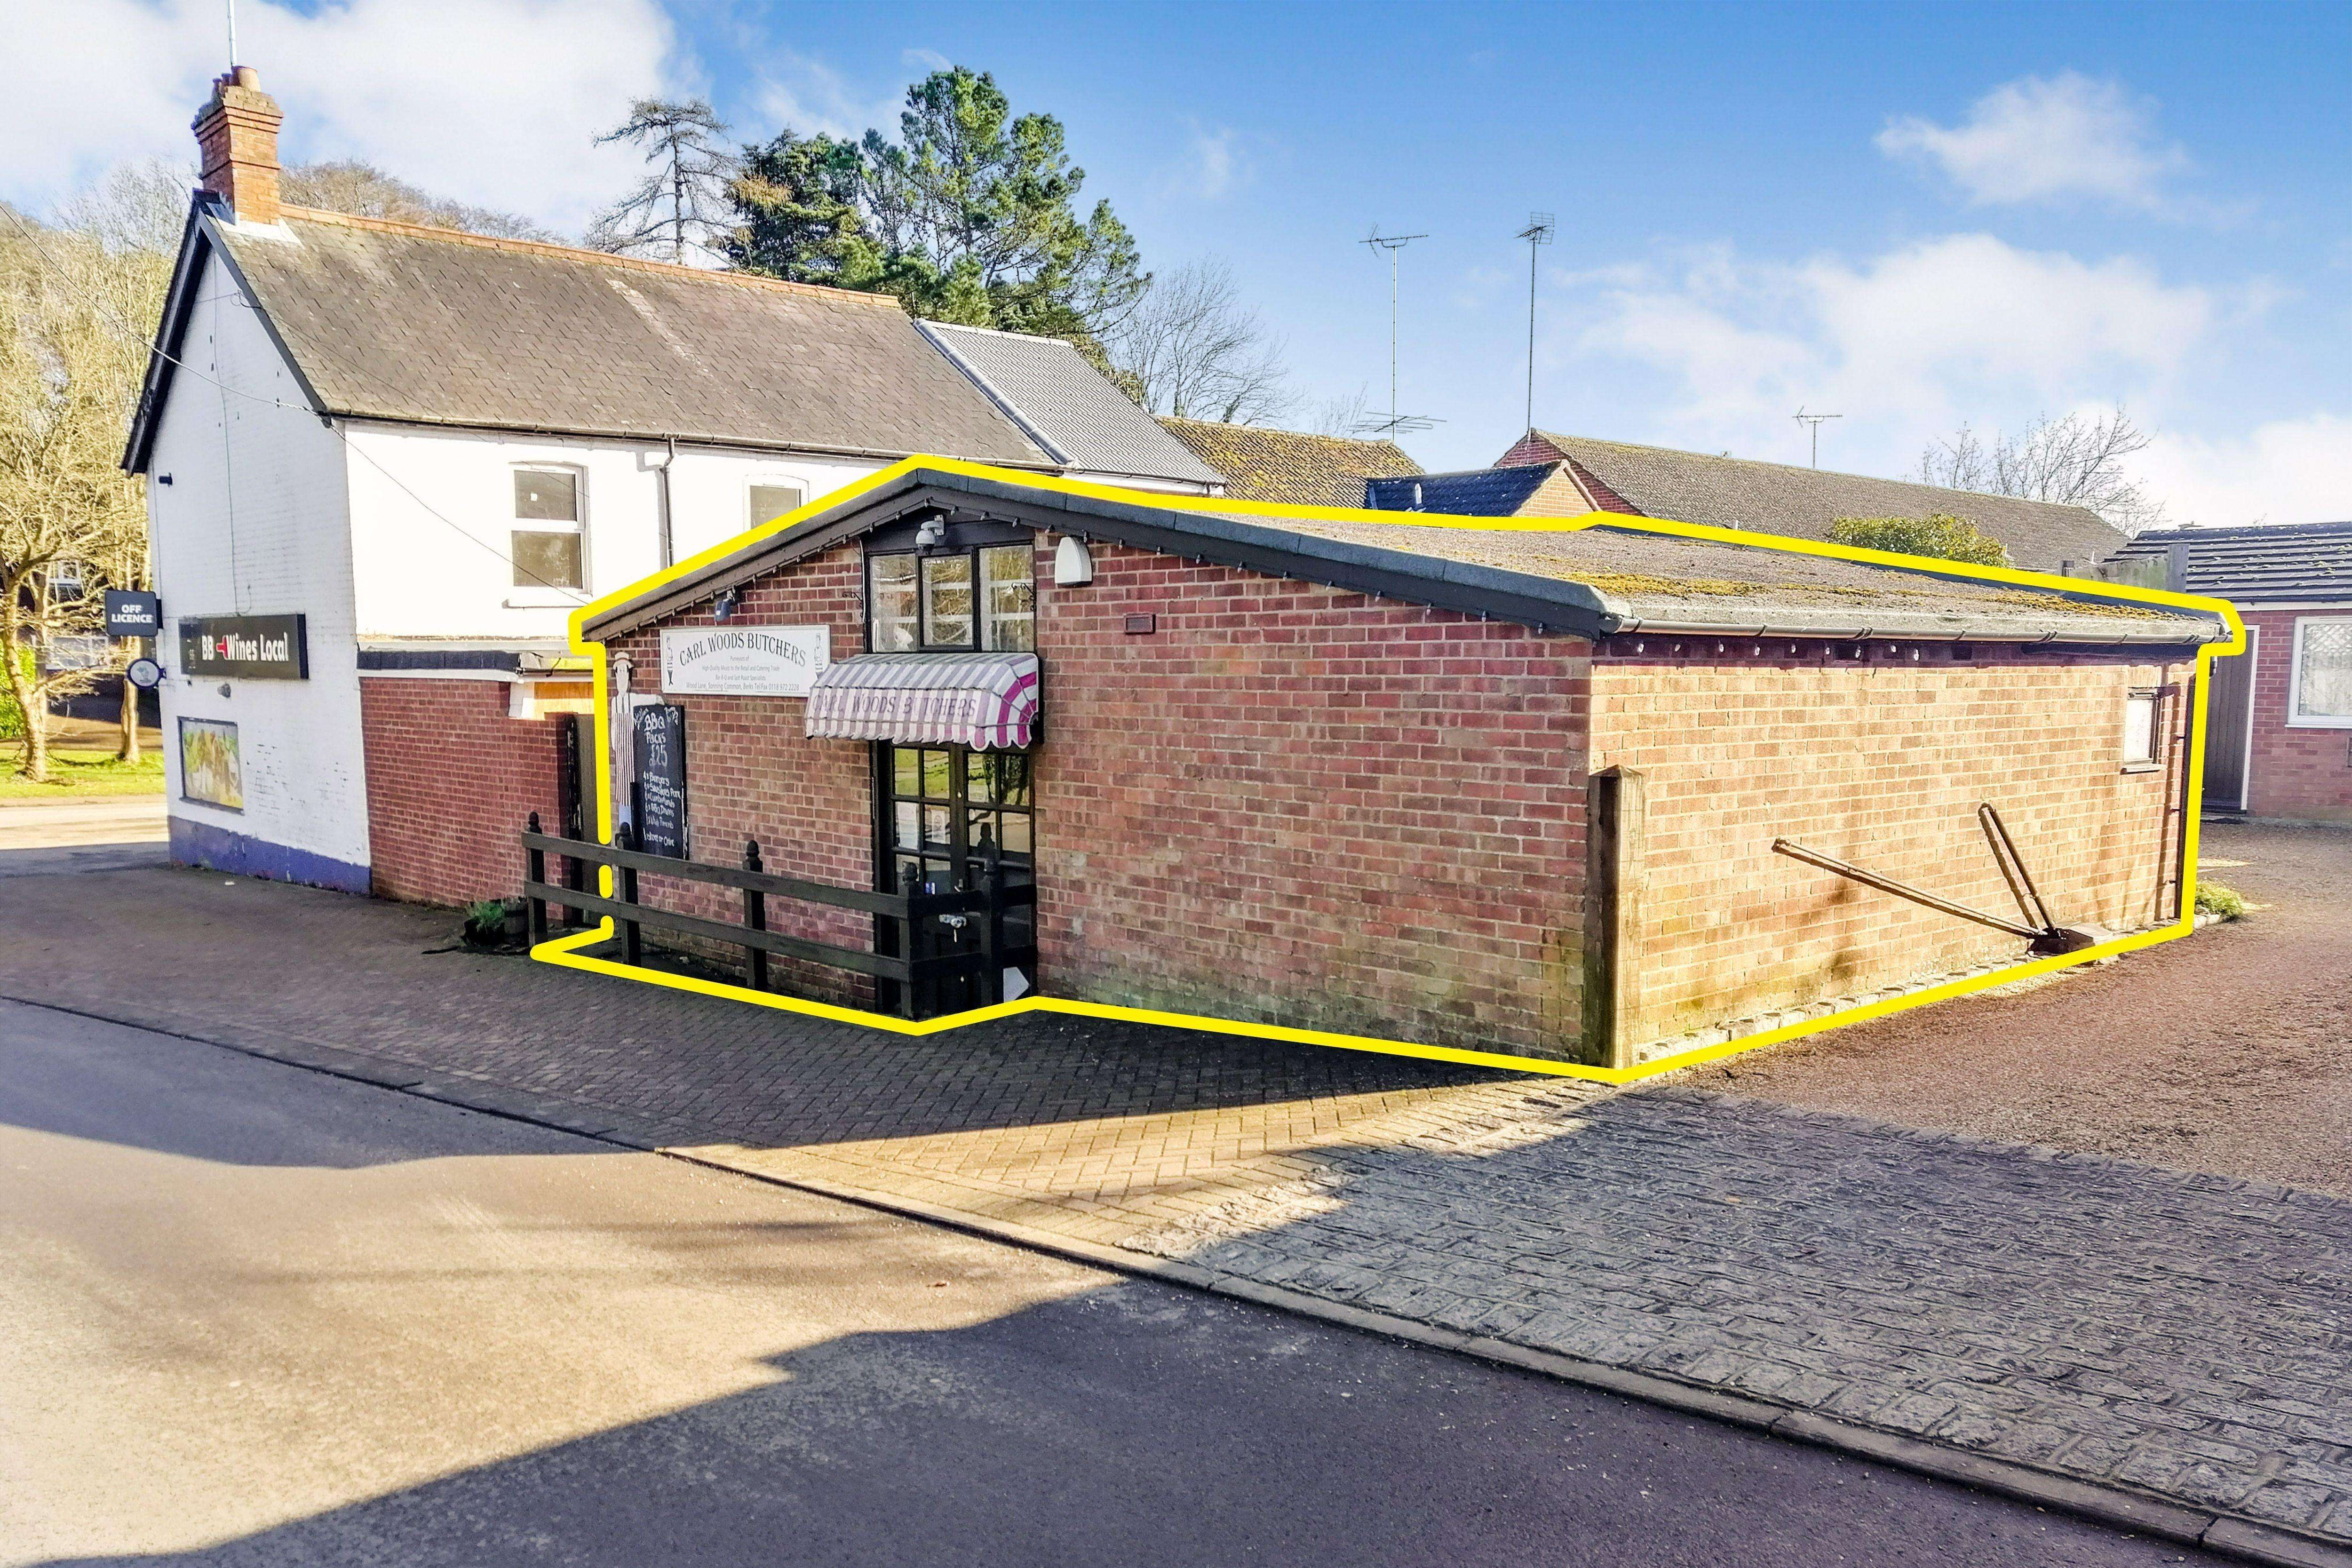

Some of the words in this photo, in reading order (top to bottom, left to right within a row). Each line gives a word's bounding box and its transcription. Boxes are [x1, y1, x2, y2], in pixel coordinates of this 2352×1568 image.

[111, 613, 152, 623] LICENCE
[121, 605, 142, 613] OFF
[201, 635, 214, 661] BB
[226, 633, 257, 661] Wines
[260, 632, 289, 661] Local
[680, 641, 706, 666] CARL
[707, 632, 744, 652] WOODS
[747, 632, 806, 667] BUTCHERS
[852, 693, 896, 713] WOODS
[903, 696, 976, 717] BTCHERS
[644, 712, 666, 732] BBQ
[650, 772, 669, 787] Burgers
